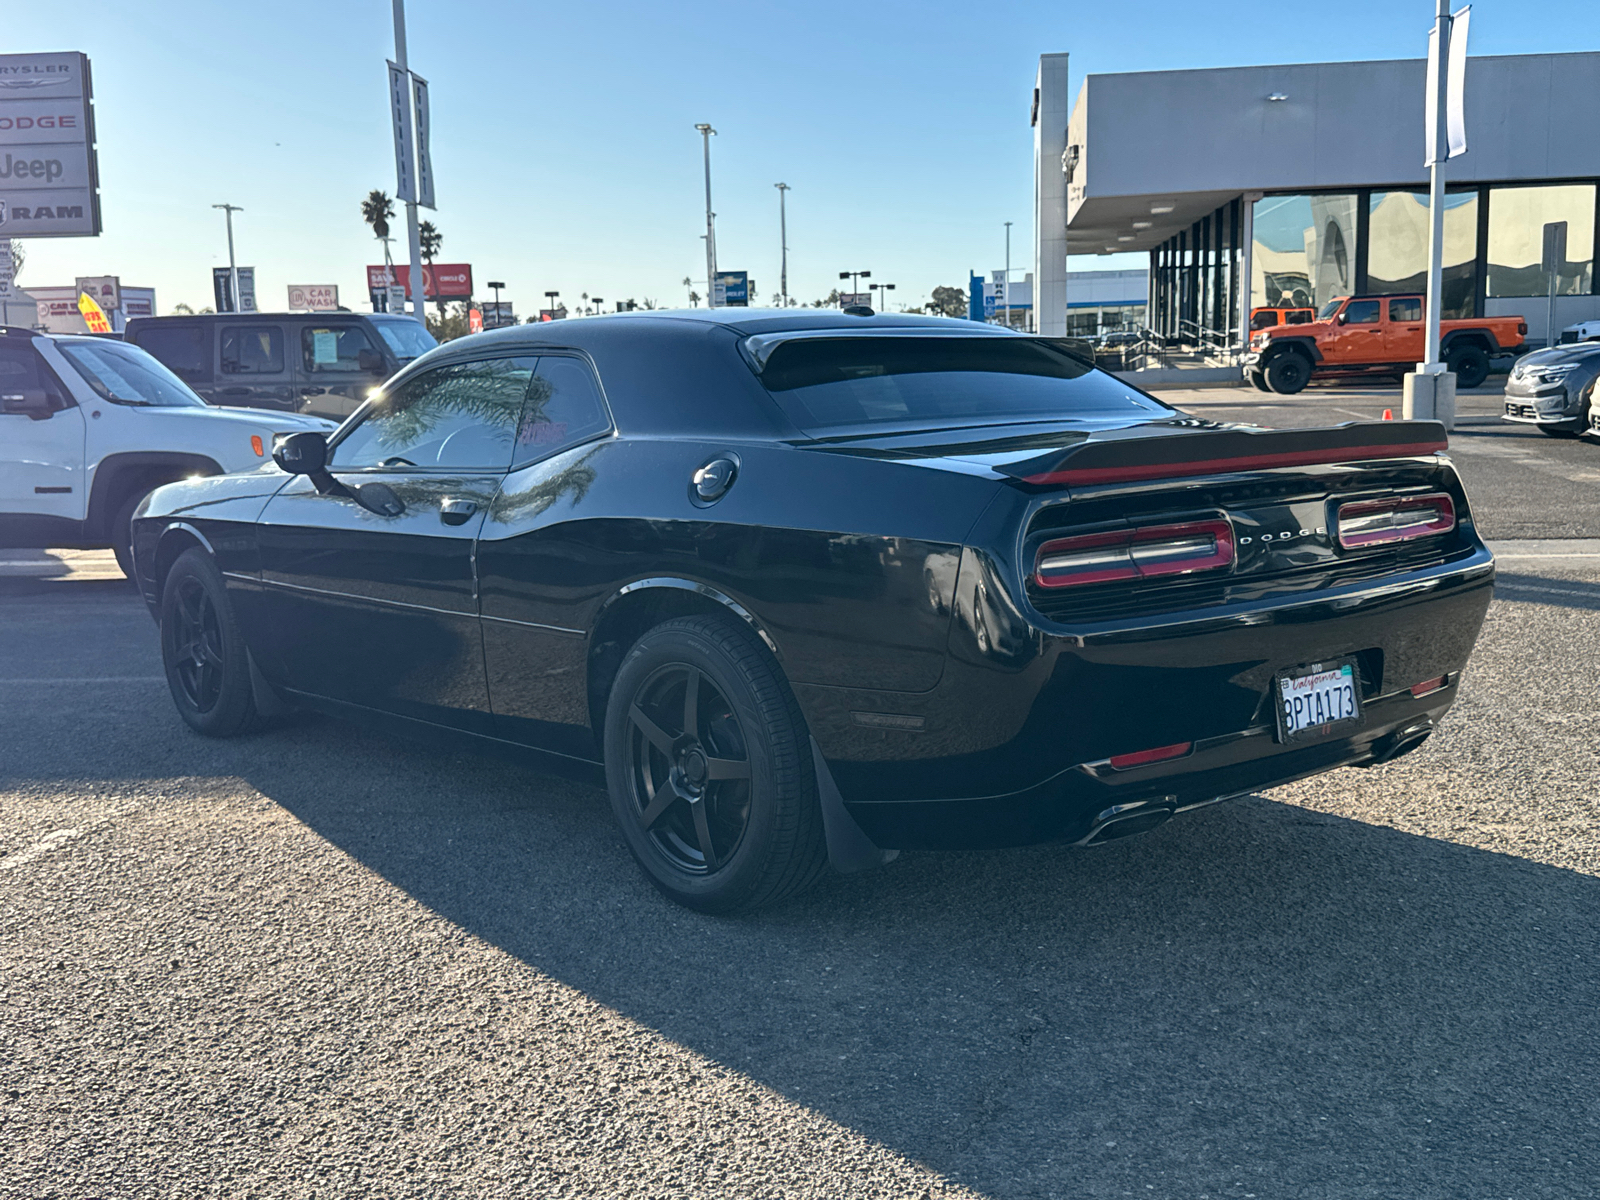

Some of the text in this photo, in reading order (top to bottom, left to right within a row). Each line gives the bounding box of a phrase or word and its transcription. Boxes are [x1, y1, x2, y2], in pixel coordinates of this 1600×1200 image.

[0, 153, 63, 183] Jeep
[12, 206, 83, 220] RAM
[306, 298, 337, 307] WASH
[309, 288, 331, 299] CAR
[1240, 526, 1326, 545] DODGE
[1292, 671, 1342, 691] California
[1284, 685, 1354, 731] 8PIA173
